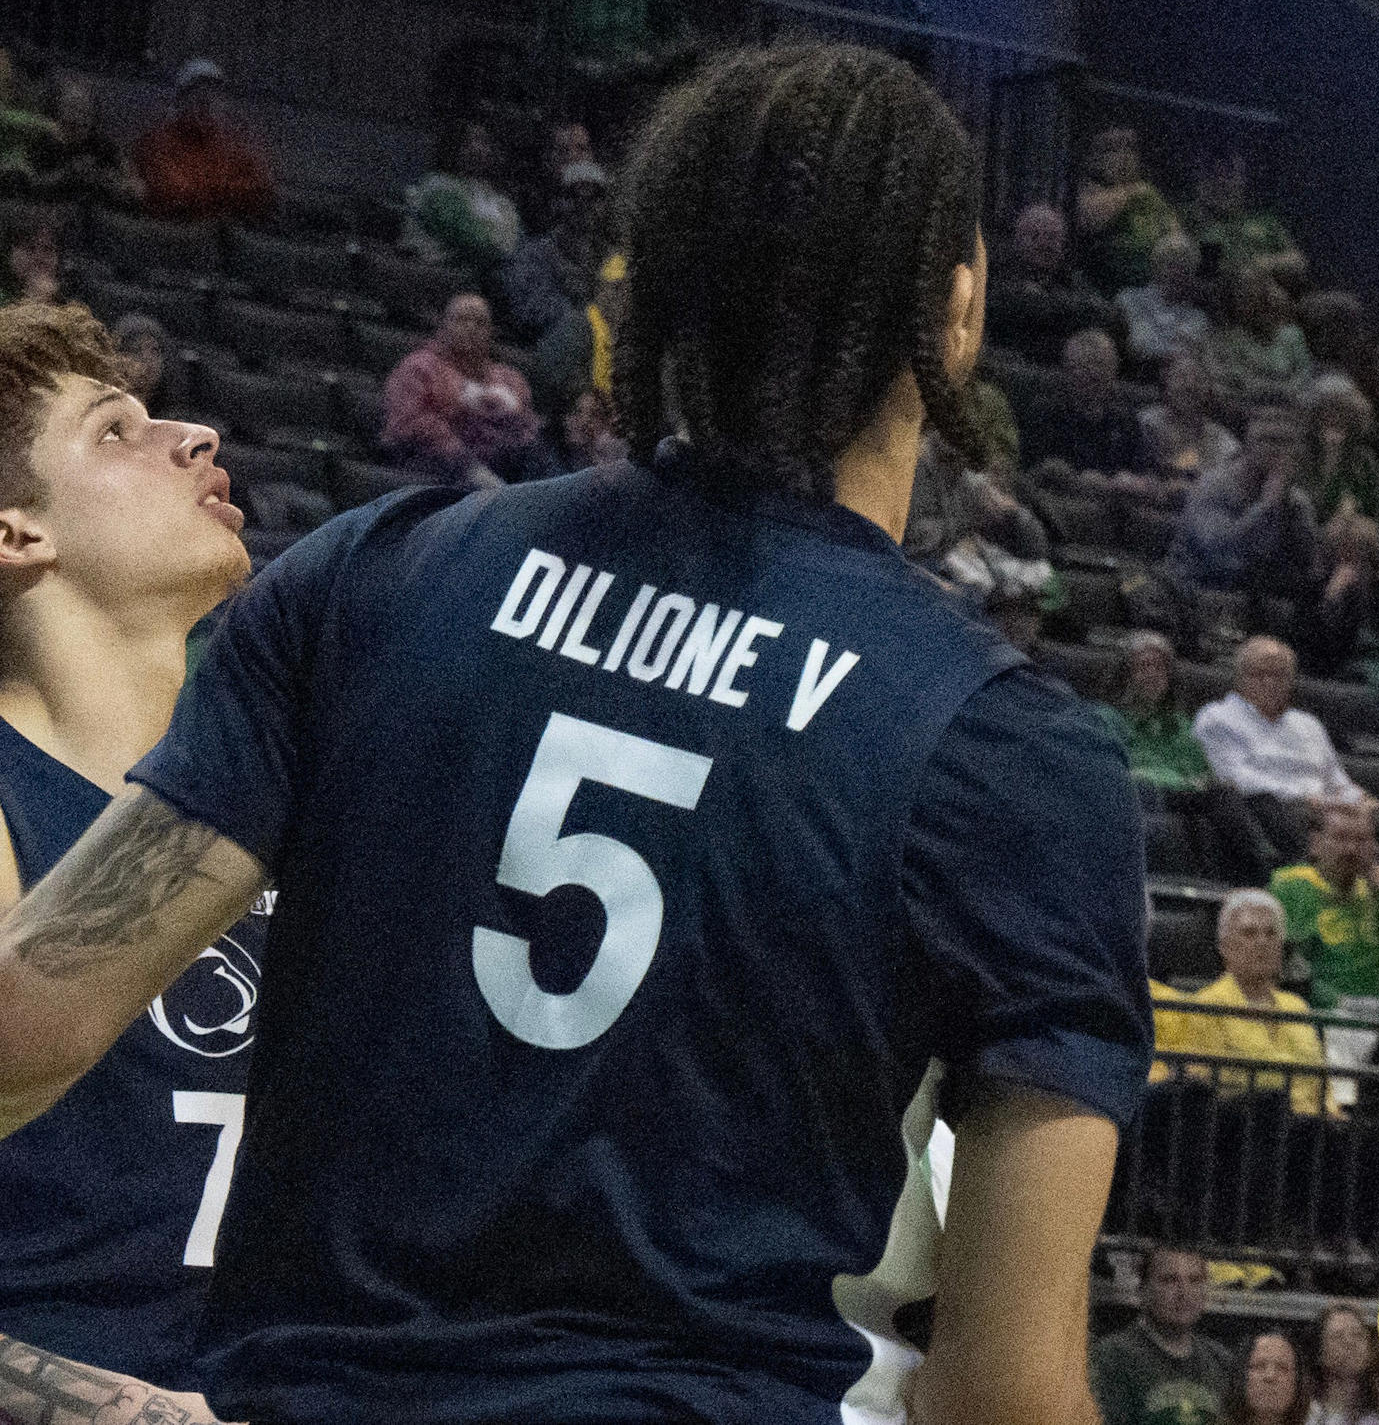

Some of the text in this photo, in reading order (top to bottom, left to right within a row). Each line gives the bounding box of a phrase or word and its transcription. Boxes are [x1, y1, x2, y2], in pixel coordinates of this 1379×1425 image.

[490, 548, 861, 732] DILIONE V
[472, 711, 713, 1050] 5
[172, 1090, 246, 1268] 7
